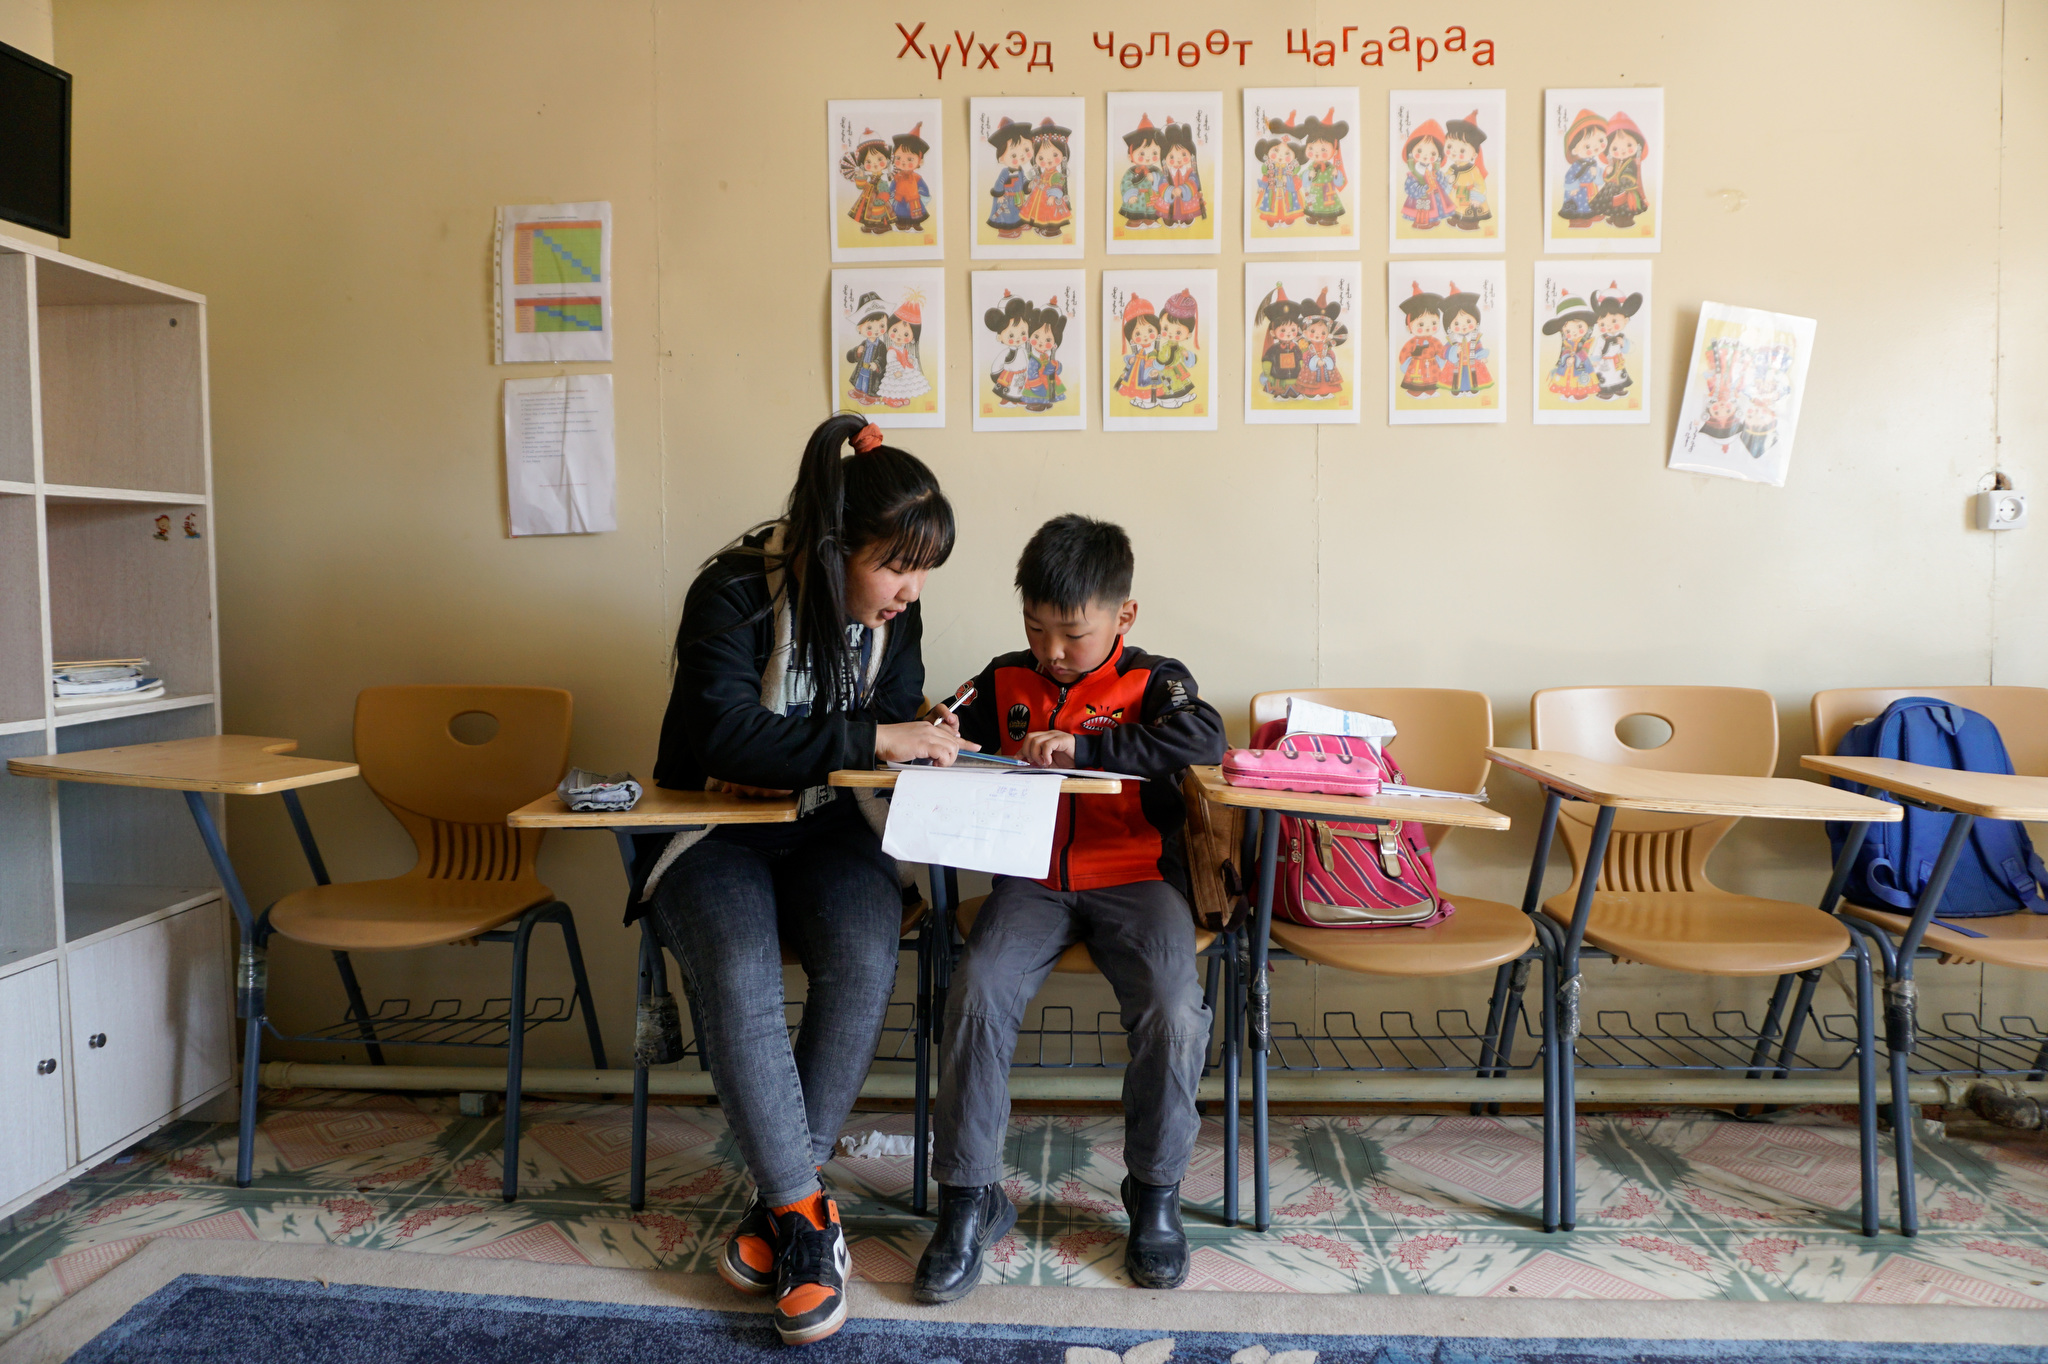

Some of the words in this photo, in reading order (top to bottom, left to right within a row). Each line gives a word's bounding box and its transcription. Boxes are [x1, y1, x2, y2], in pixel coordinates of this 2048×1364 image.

[896, 22, 1054, 80] Хүүхэд
[1092, 29, 1253, 69] чөлөөт
[1286, 26, 1495, 72] цагаараа
